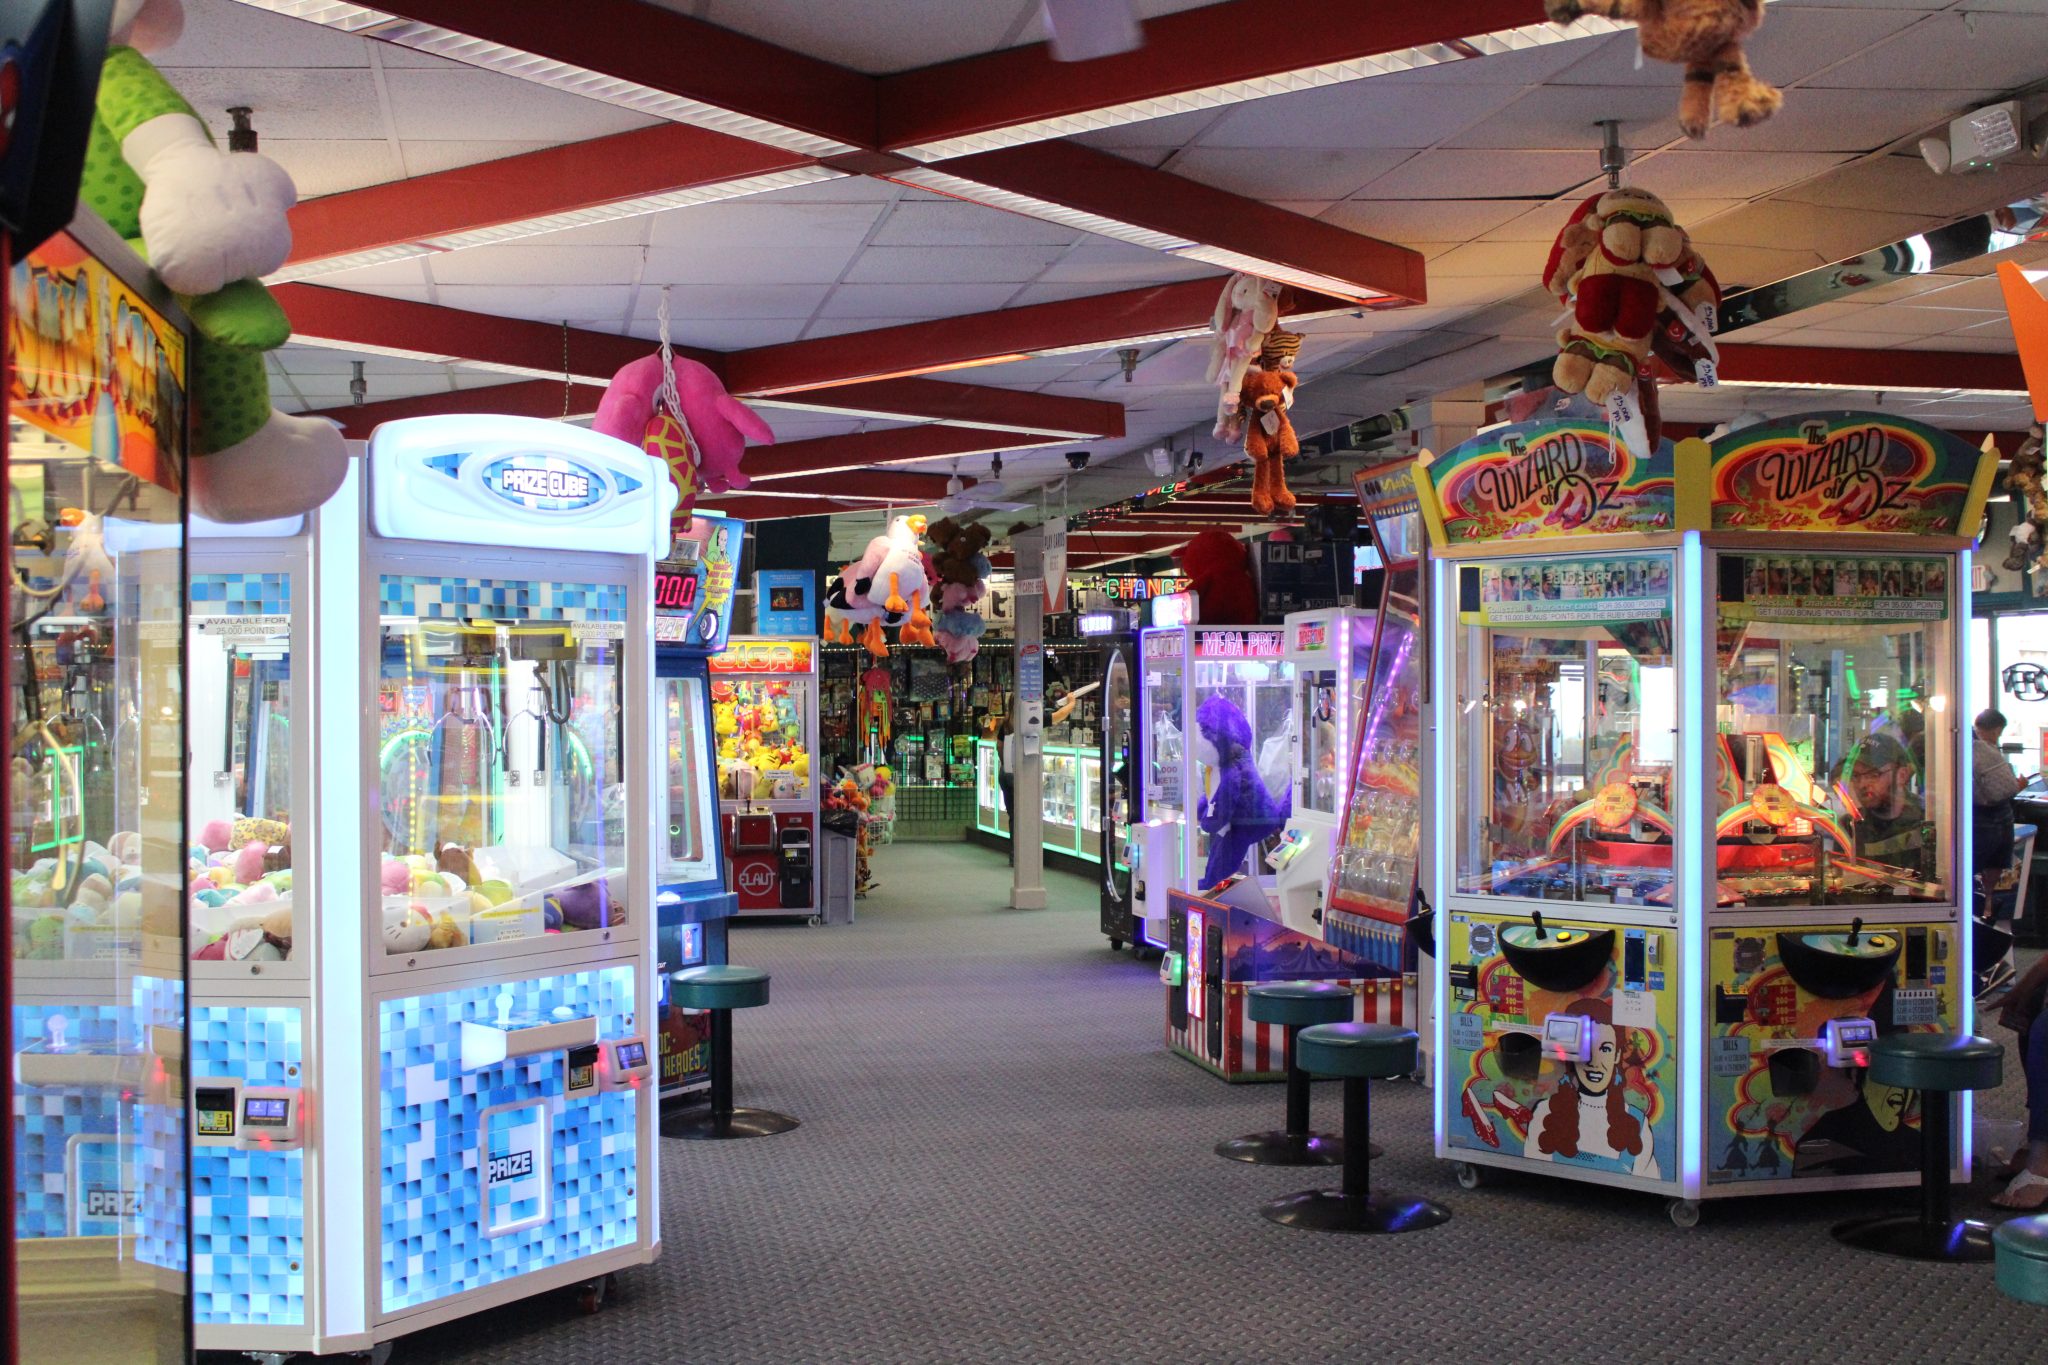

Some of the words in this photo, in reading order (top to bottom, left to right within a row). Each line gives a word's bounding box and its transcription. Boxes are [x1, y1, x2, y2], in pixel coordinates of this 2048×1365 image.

[1804, 425, 1827, 445] The
[1504, 437, 1527, 457] The
[1478, 432, 1582, 512] WIZARD
[1761, 427, 1884, 501] WIZARD
[502, 468, 548, 496] PRIZE
[548, 471, 589, 498] CUBE
[1540, 481, 1554, 506] of
[1823, 477, 1841, 499] of
[1106, 578, 1189, 600] CHANGE
[206, 617, 262, 625] AVAILABLE
[1576, 612, 1590, 620] FOR
[244, 626, 275, 635] POINTS
[1202, 631, 1244, 657] MEGA
[713, 644, 794, 671] GIGA
[739, 872, 776, 886] ELAUT
[664, 1043, 701, 1078] HEROES
[488, 1152, 531, 1184] PRIZE
